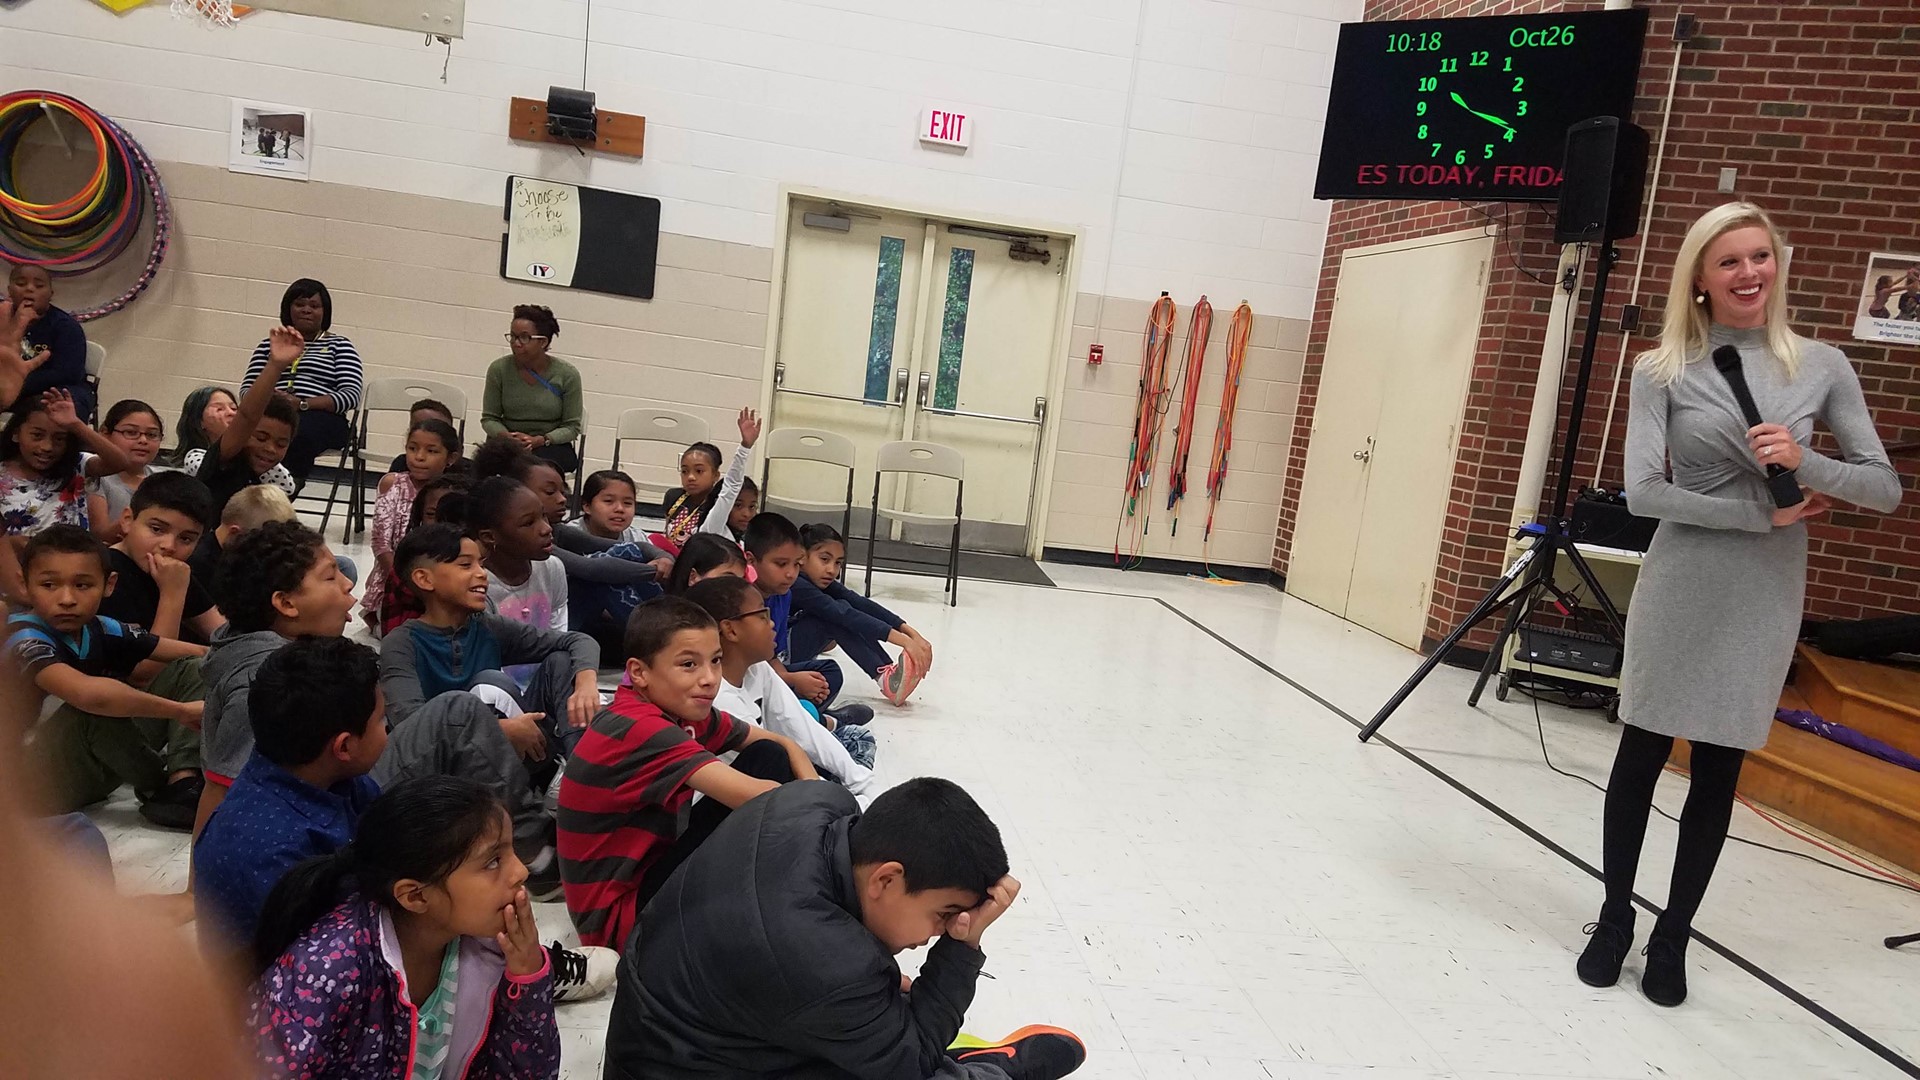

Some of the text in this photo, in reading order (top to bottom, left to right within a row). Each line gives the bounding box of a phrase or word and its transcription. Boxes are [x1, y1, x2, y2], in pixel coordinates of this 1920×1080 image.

[1386, 31, 1442, 53] 10:18
[1509, 25, 1576, 48] Oct26
[1439, 58, 1458, 73] 11
[1469, 51, 1489, 66] 12
[1503, 57, 1513, 72] 1
[1418, 77, 1438, 92] 10
[1512, 77, 1524, 92] 2
[1416, 101, 1427, 116] 9
[1516, 100, 1528, 116] 3
[930, 110, 965, 142] EXIT
[1417, 125, 1428, 139] 8
[1503, 128, 1514, 143] 4
[1431, 143, 1442, 157] 7
[1455, 150, 1465, 164] 6
[1484, 144, 1494, 159] 5
[1357, 165, 1389, 185] ES
[1396, 165, 1485, 188] TODAY,
